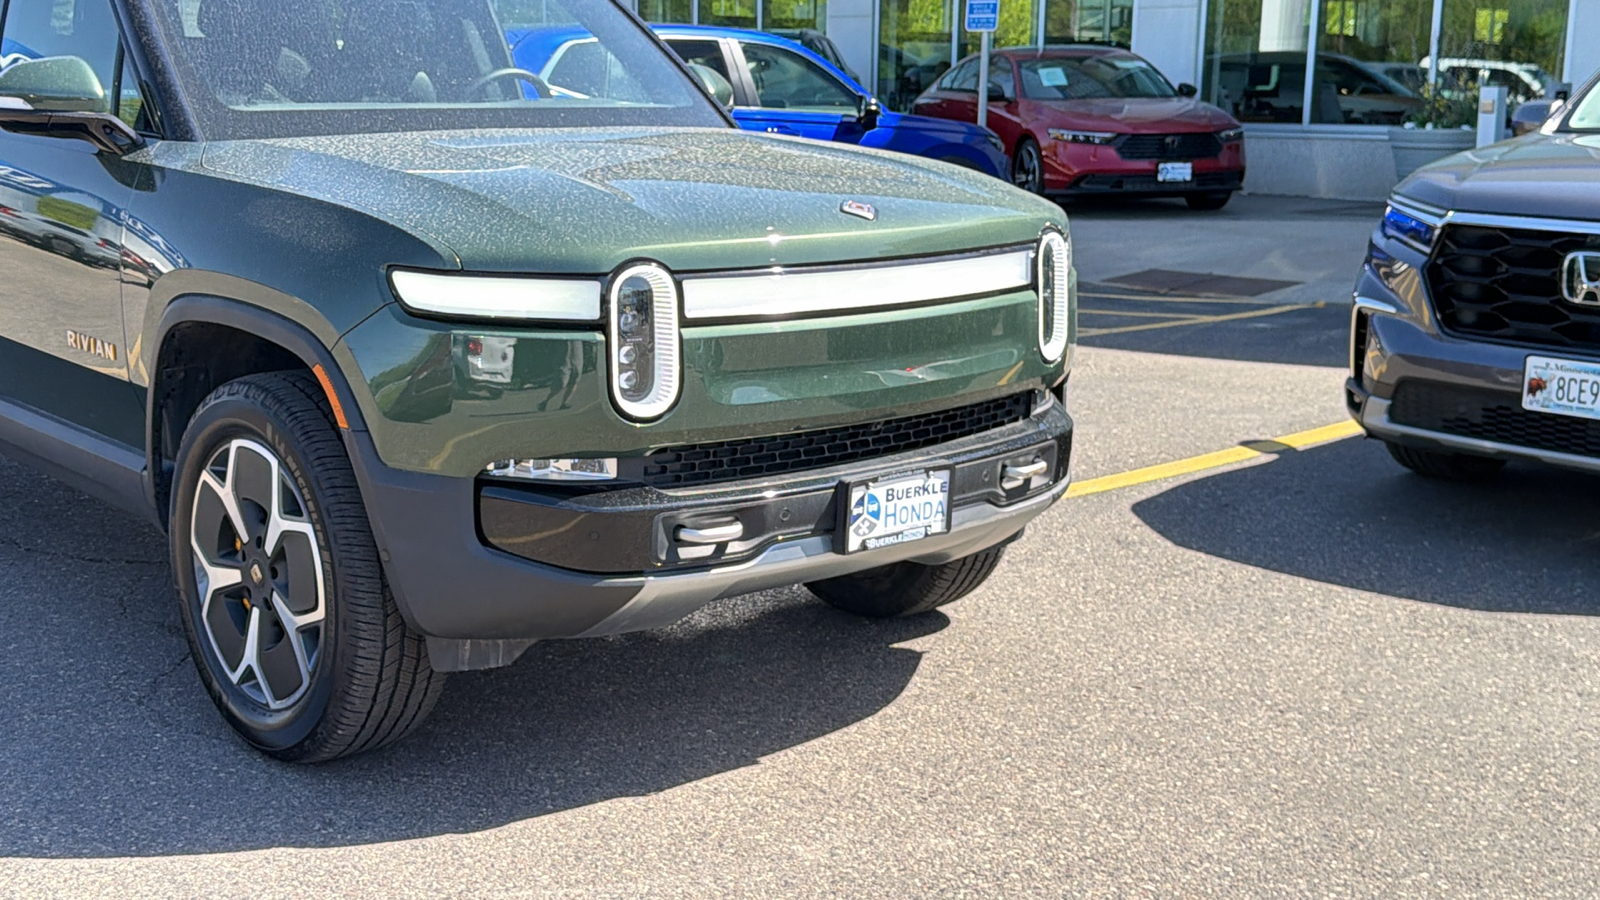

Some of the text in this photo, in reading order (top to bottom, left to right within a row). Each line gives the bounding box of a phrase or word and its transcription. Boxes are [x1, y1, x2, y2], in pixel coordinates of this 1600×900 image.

[66, 329, 117, 361] RIVIAN
[1555, 376, 1600, 406] 8CE9
[285, 454, 326, 547] MICHELIN
[885, 481, 948, 503] BUERKLE
[884, 500, 946, 528] HONDA
